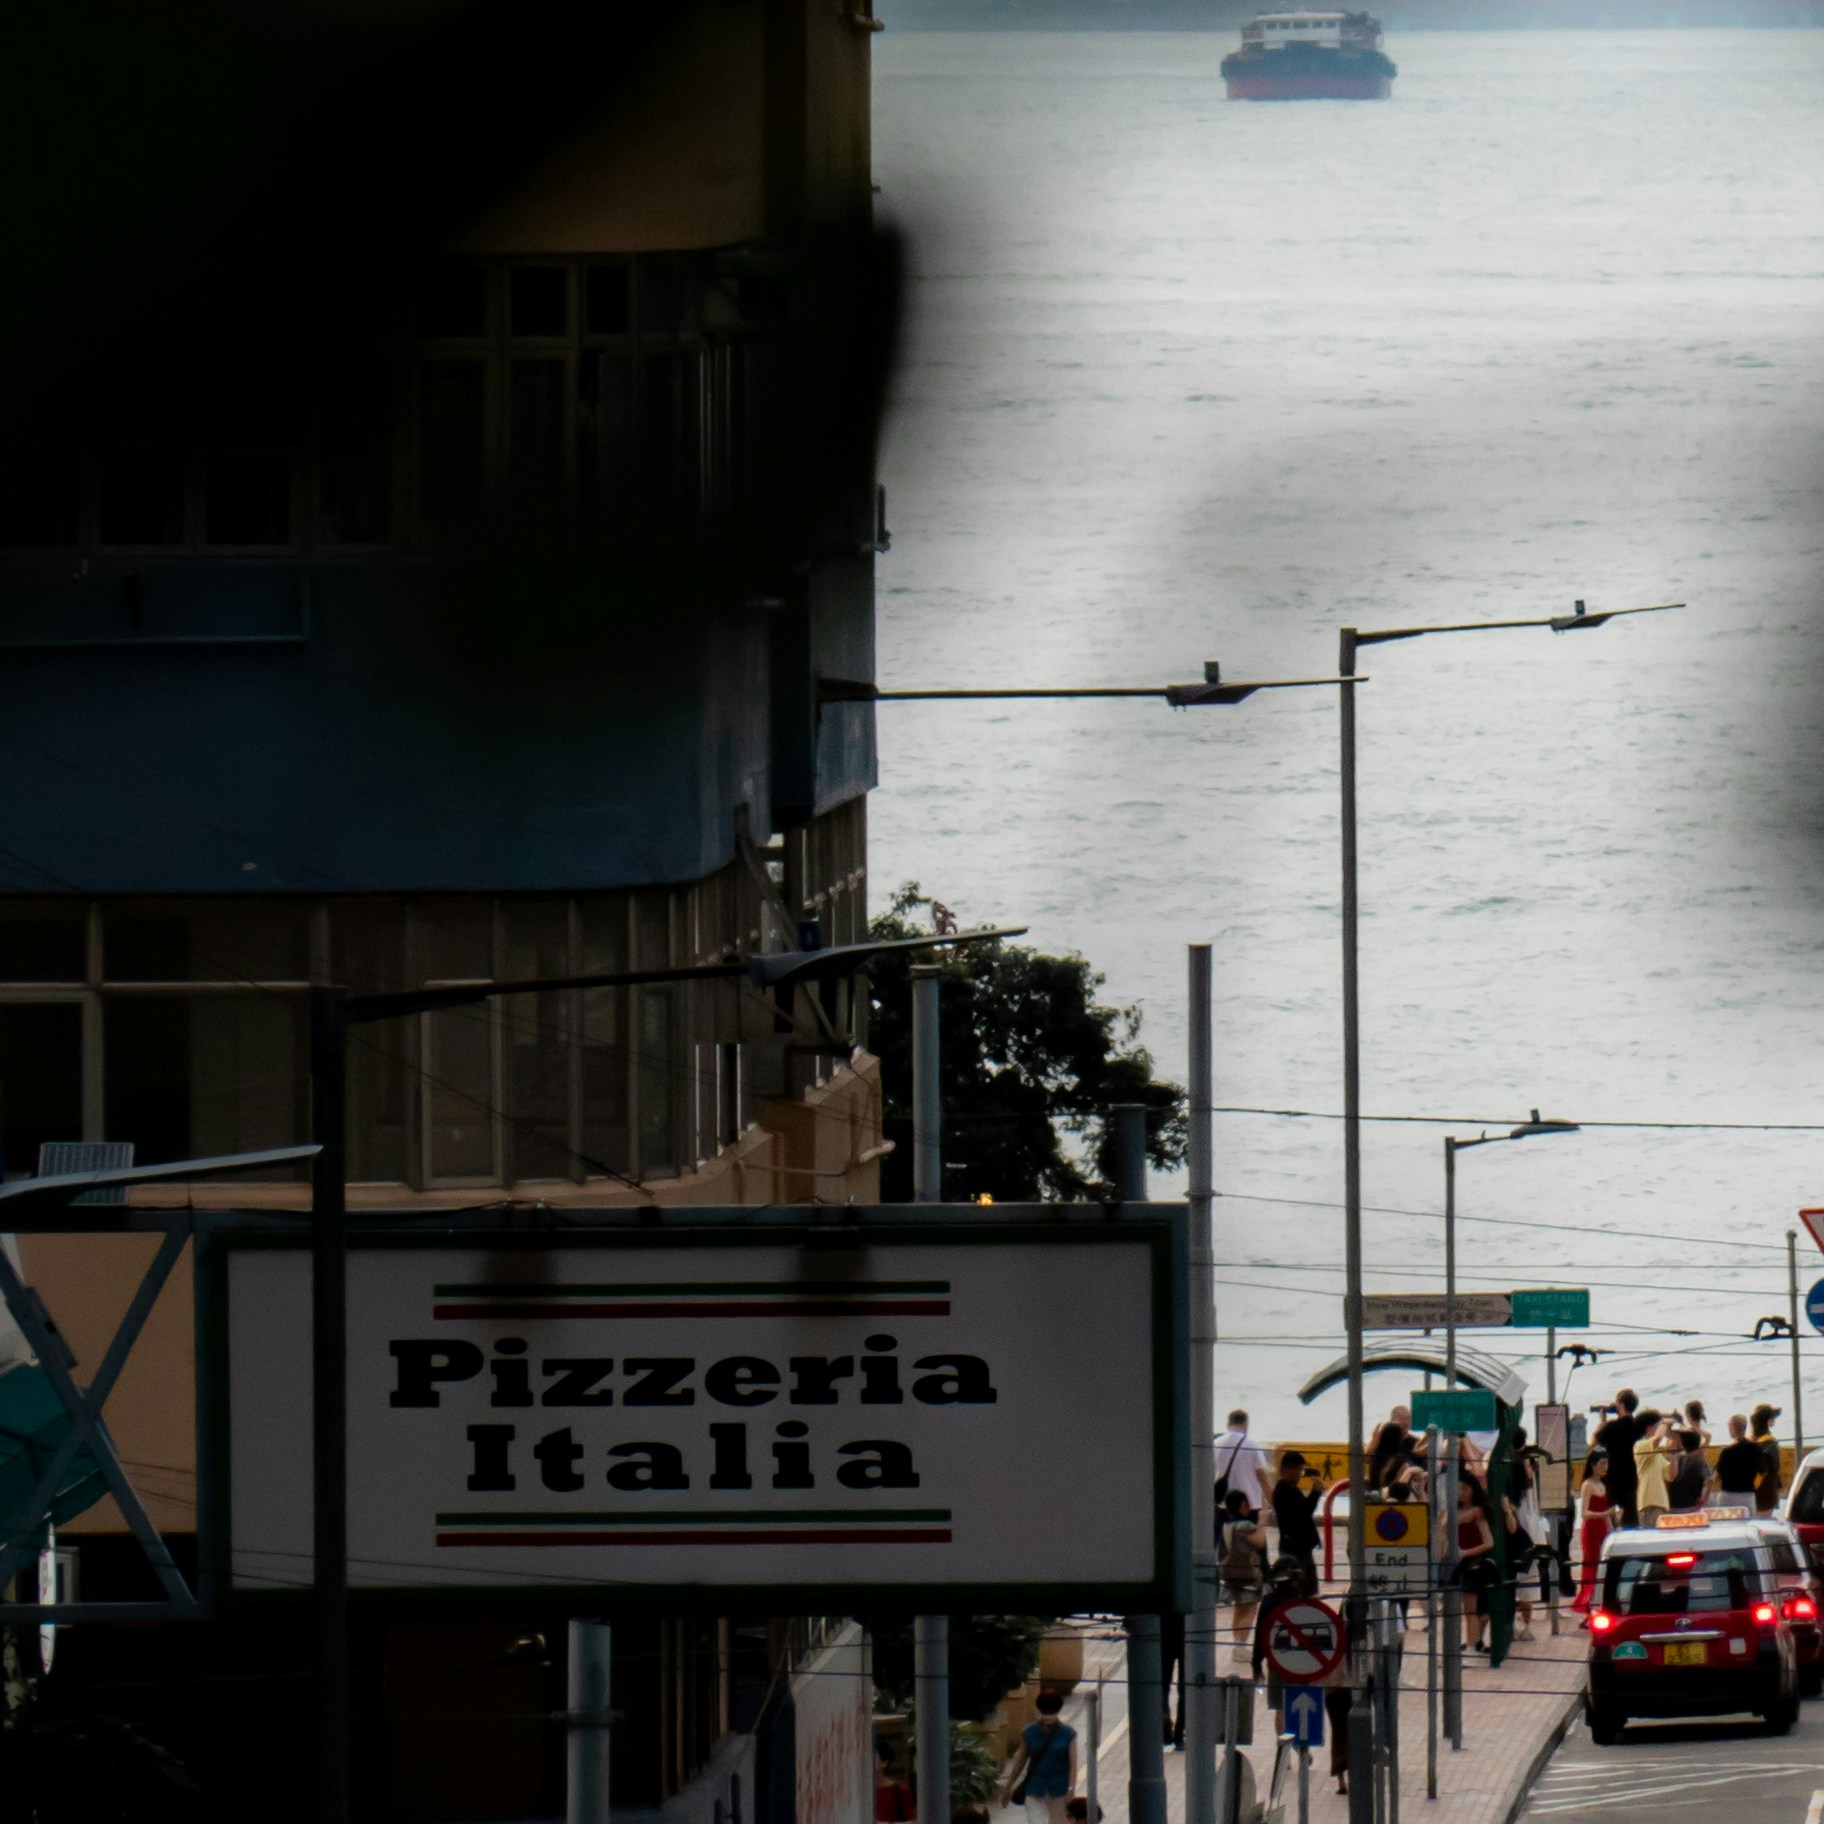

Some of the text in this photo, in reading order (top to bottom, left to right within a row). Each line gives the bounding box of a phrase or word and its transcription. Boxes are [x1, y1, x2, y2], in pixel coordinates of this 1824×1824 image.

[389, 1334, 998, 1408] Pizzeria
[466, 1420, 920, 1492] Italia
[1376, 1552, 1408, 1565] End
